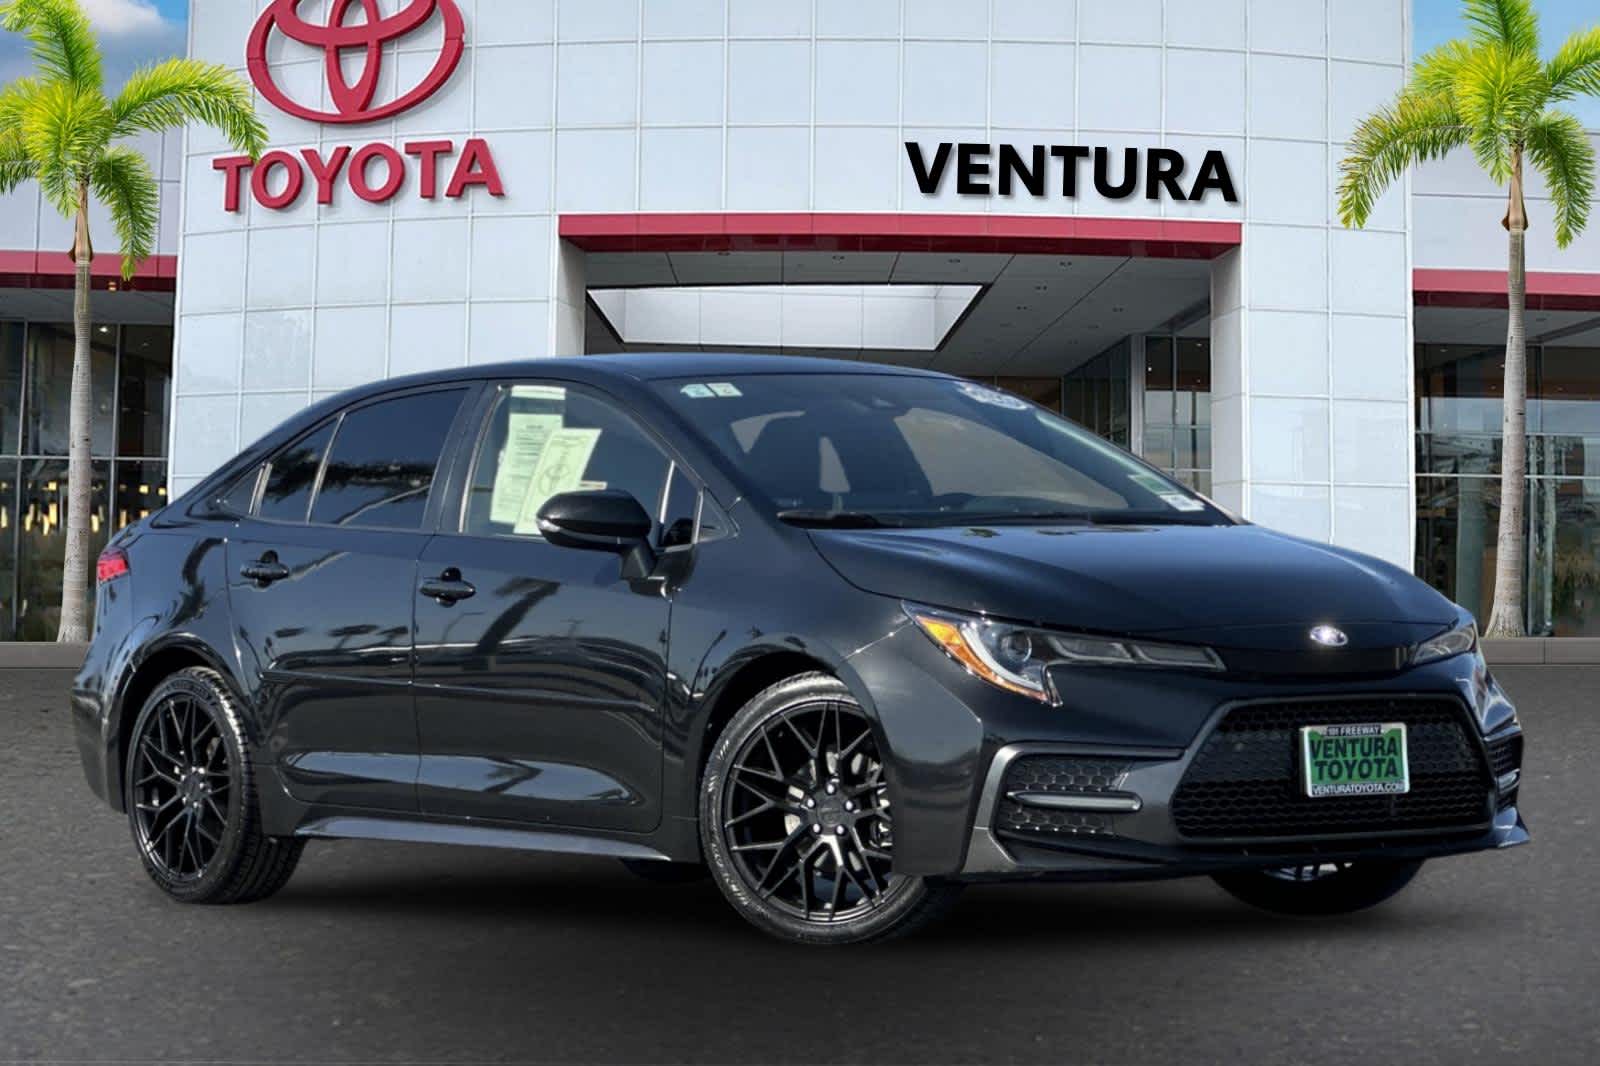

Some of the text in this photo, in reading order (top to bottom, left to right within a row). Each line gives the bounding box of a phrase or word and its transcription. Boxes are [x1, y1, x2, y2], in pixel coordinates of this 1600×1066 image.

[212, 138, 505, 212] TOYOTA
[904, 141, 1238, 202] VENTURA
[1340, 727, 1379, 736] FREEWAY
[1310, 736, 1398, 760] VENTURA
[1314, 757, 1399, 780] TOYOTA
